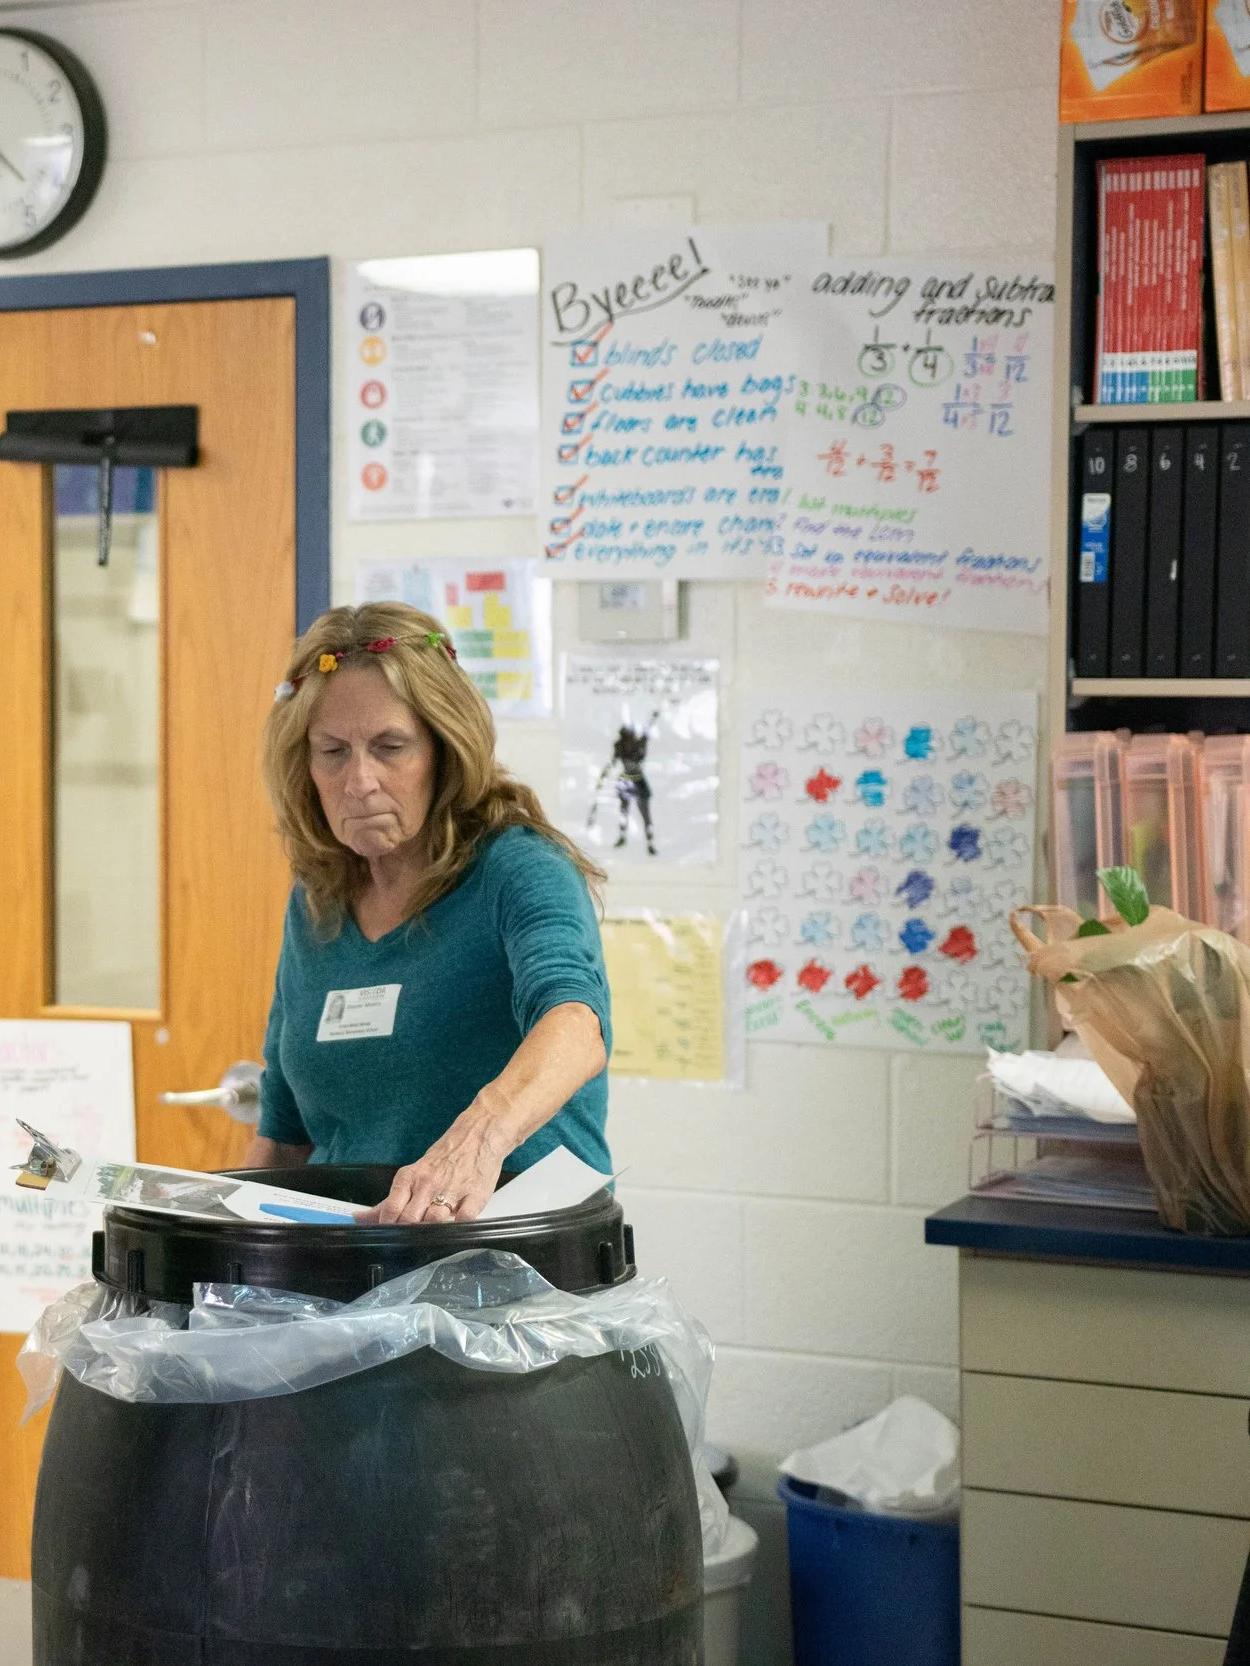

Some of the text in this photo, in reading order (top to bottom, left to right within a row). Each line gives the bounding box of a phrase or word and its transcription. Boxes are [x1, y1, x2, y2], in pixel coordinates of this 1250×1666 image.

[21, 52, 30, 72] 1
[50, 79, 63, 105] 2
[24, 204, 38, 229] 5
[919, 271, 975, 302] and
[913, 302, 1033, 328] fractions
[604, 333, 764, 367] blinds closed
[682, 375, 729, 399] have
[740, 372, 798, 408] bags
[640, 444, 727, 468] counter
[1088, 451, 1242, 475] 10 8 6 4 2
